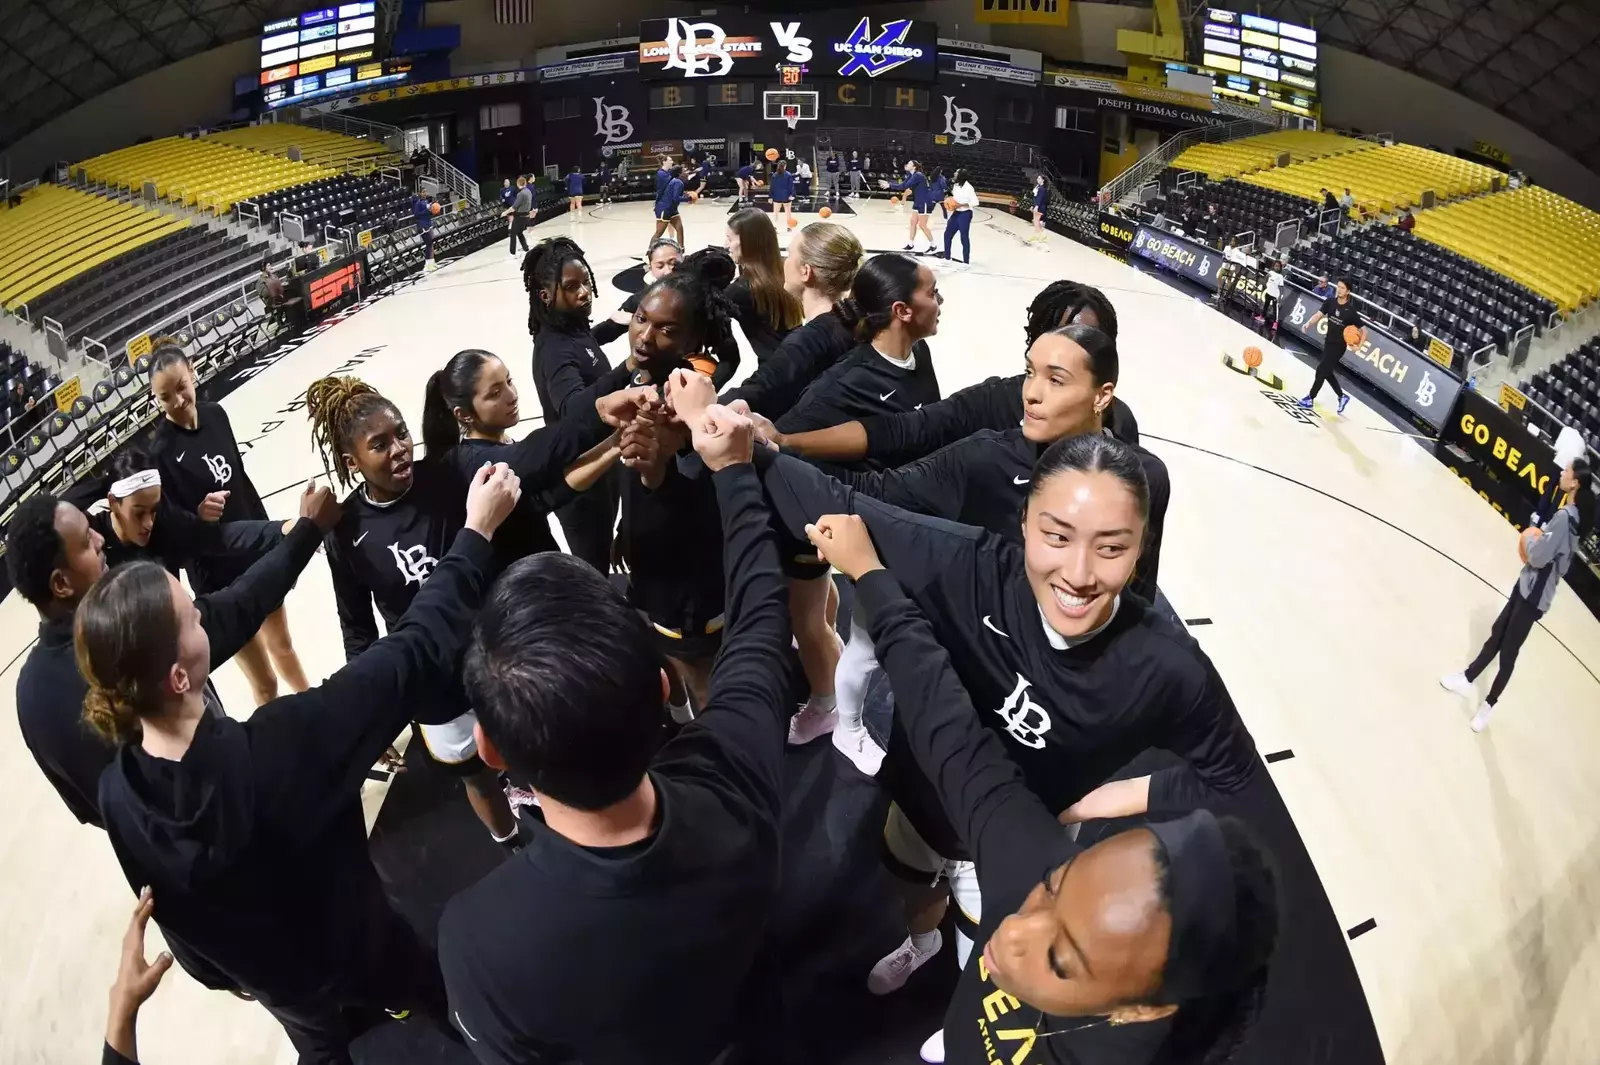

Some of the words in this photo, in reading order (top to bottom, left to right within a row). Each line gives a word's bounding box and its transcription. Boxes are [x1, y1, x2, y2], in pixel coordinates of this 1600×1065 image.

[643, 46, 678, 57] LON
[722, 42, 762, 52] STATE
[769, 22, 813, 62] VS
[834, 42, 853, 53] UC
[854, 43, 882, 55] SAN
[883, 46, 923, 58] DIEGO
[950, 40, 986, 50] WOMEN
[783, 72, 799, 83] 20
[984, 65, 1007, 73] THOMAS
[1097, 97, 1131, 110] JOSEPH
[1134, 103, 1177, 119] THOMAS
[1180, 111, 1226, 128] GANNON
[1100, 222, 1110, 234] GO
[1109, 227, 1133, 242] BEACH
[1146, 238, 1161, 252] GO
[1162, 244, 1196, 267] BEACH
[310, 262, 362, 310] ESPN
[1347, 340, 1409, 383] EACH
[1460, 414, 1490, 445] GO
